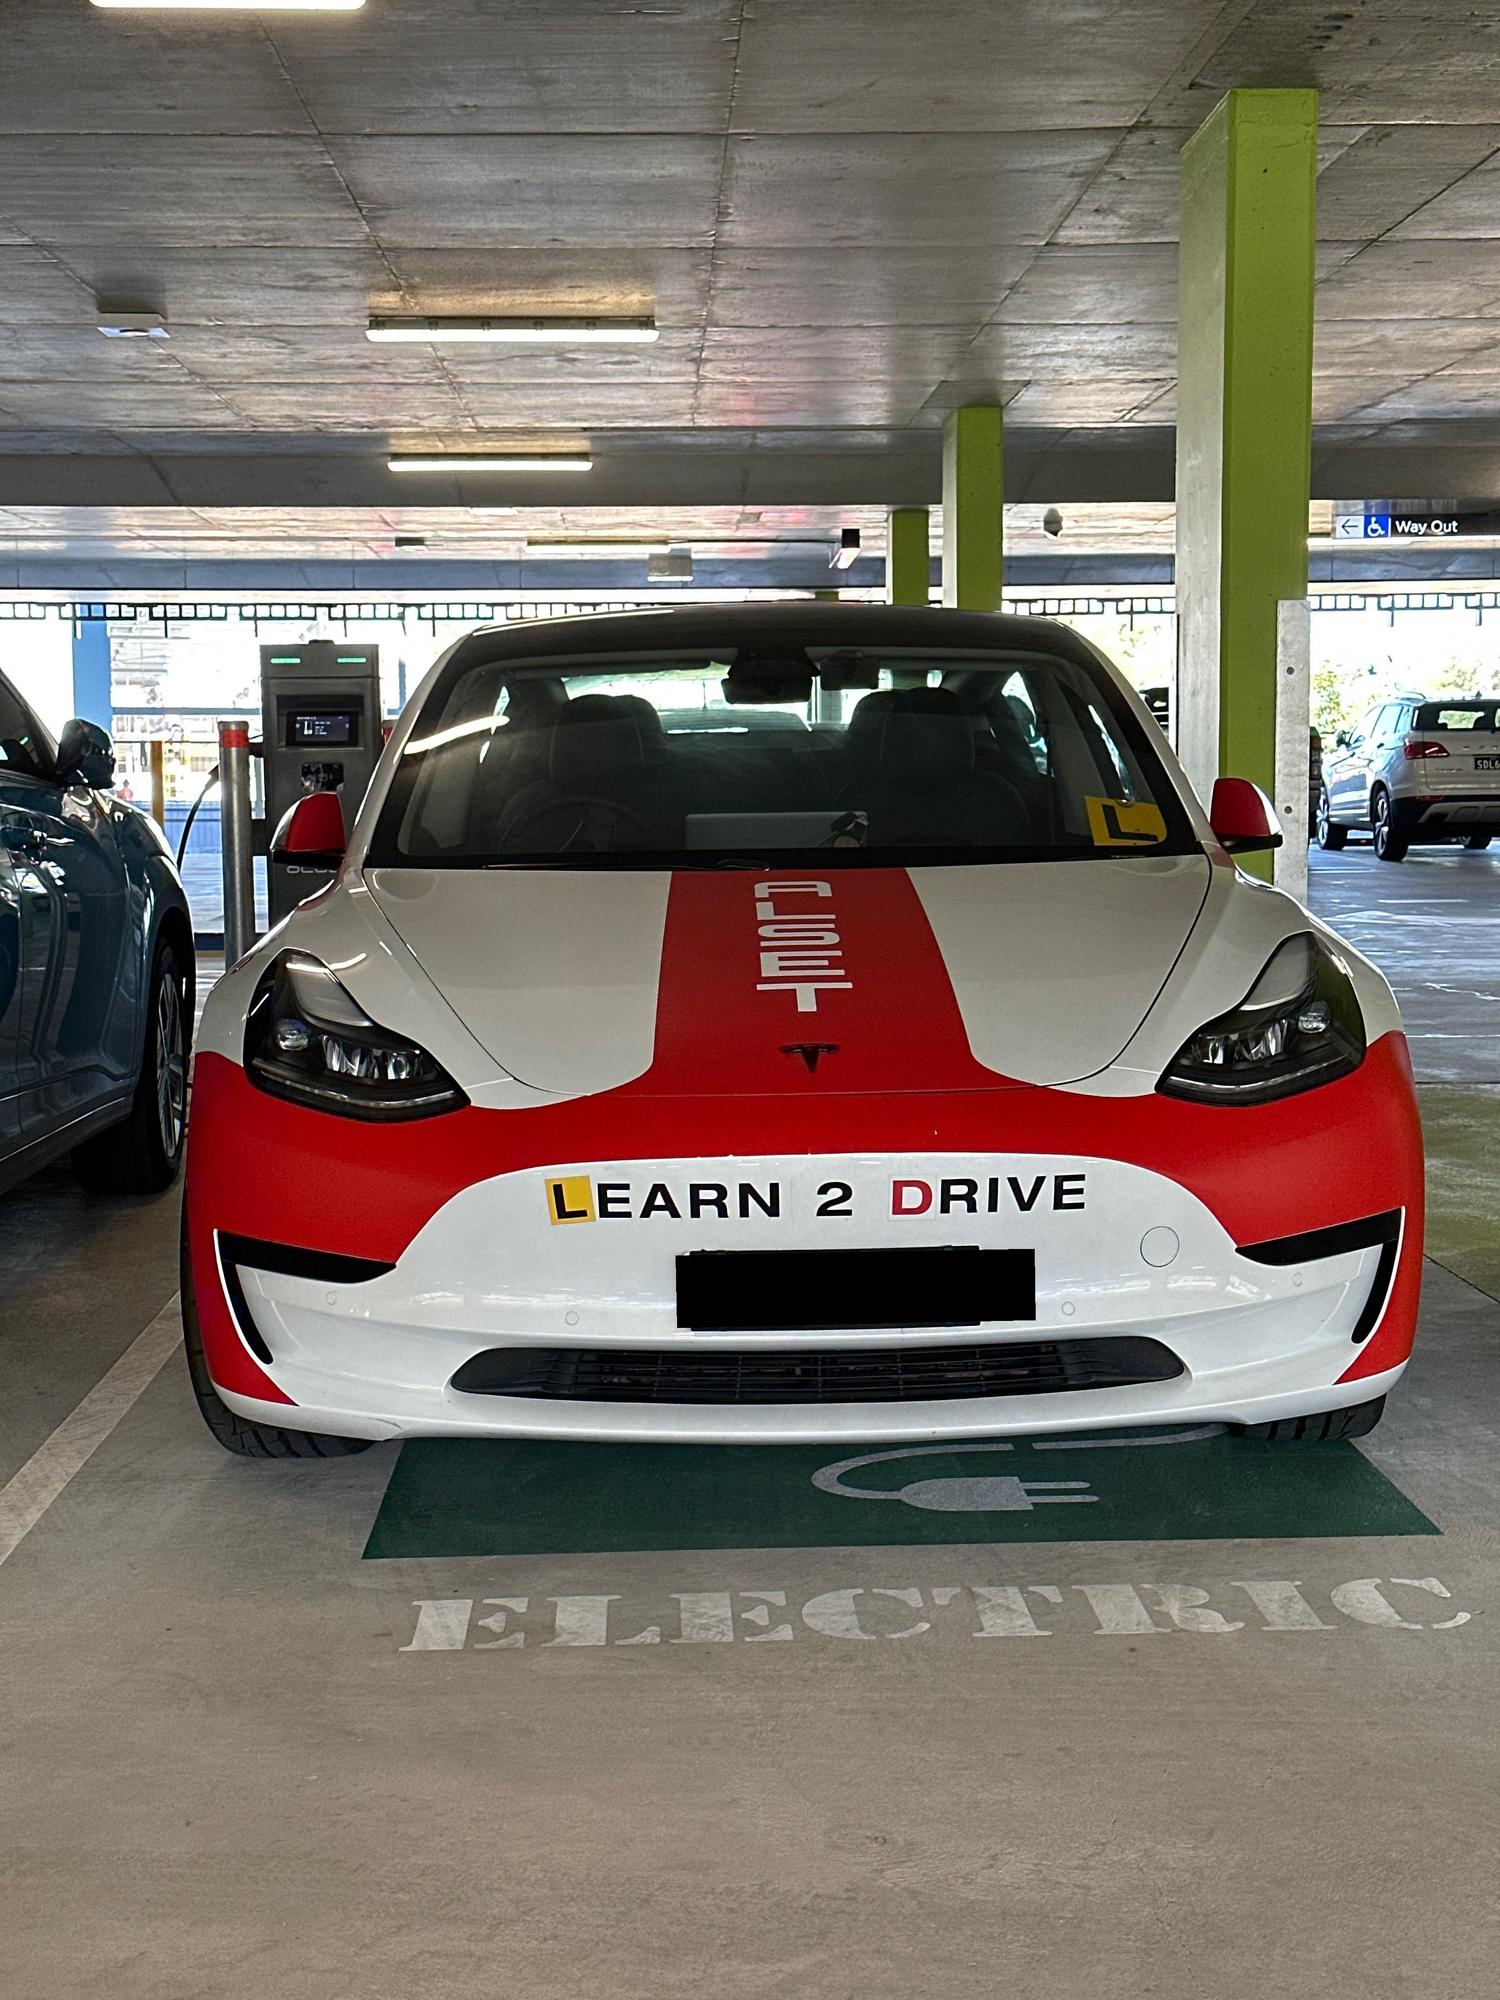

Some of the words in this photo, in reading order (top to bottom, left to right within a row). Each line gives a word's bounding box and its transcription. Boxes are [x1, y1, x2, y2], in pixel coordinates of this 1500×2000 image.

[1395, 520, 1427, 535] Way
[1430, 519, 1458, 534] Out
[1102, 804, 1158, 842] L
[552, 1182, 780, 1219] LEARN
[816, 1181, 853, 1216] 2
[891, 1174, 1086, 1216] DRIVE
[399, 1577, 1473, 1652] ELECTRIC
